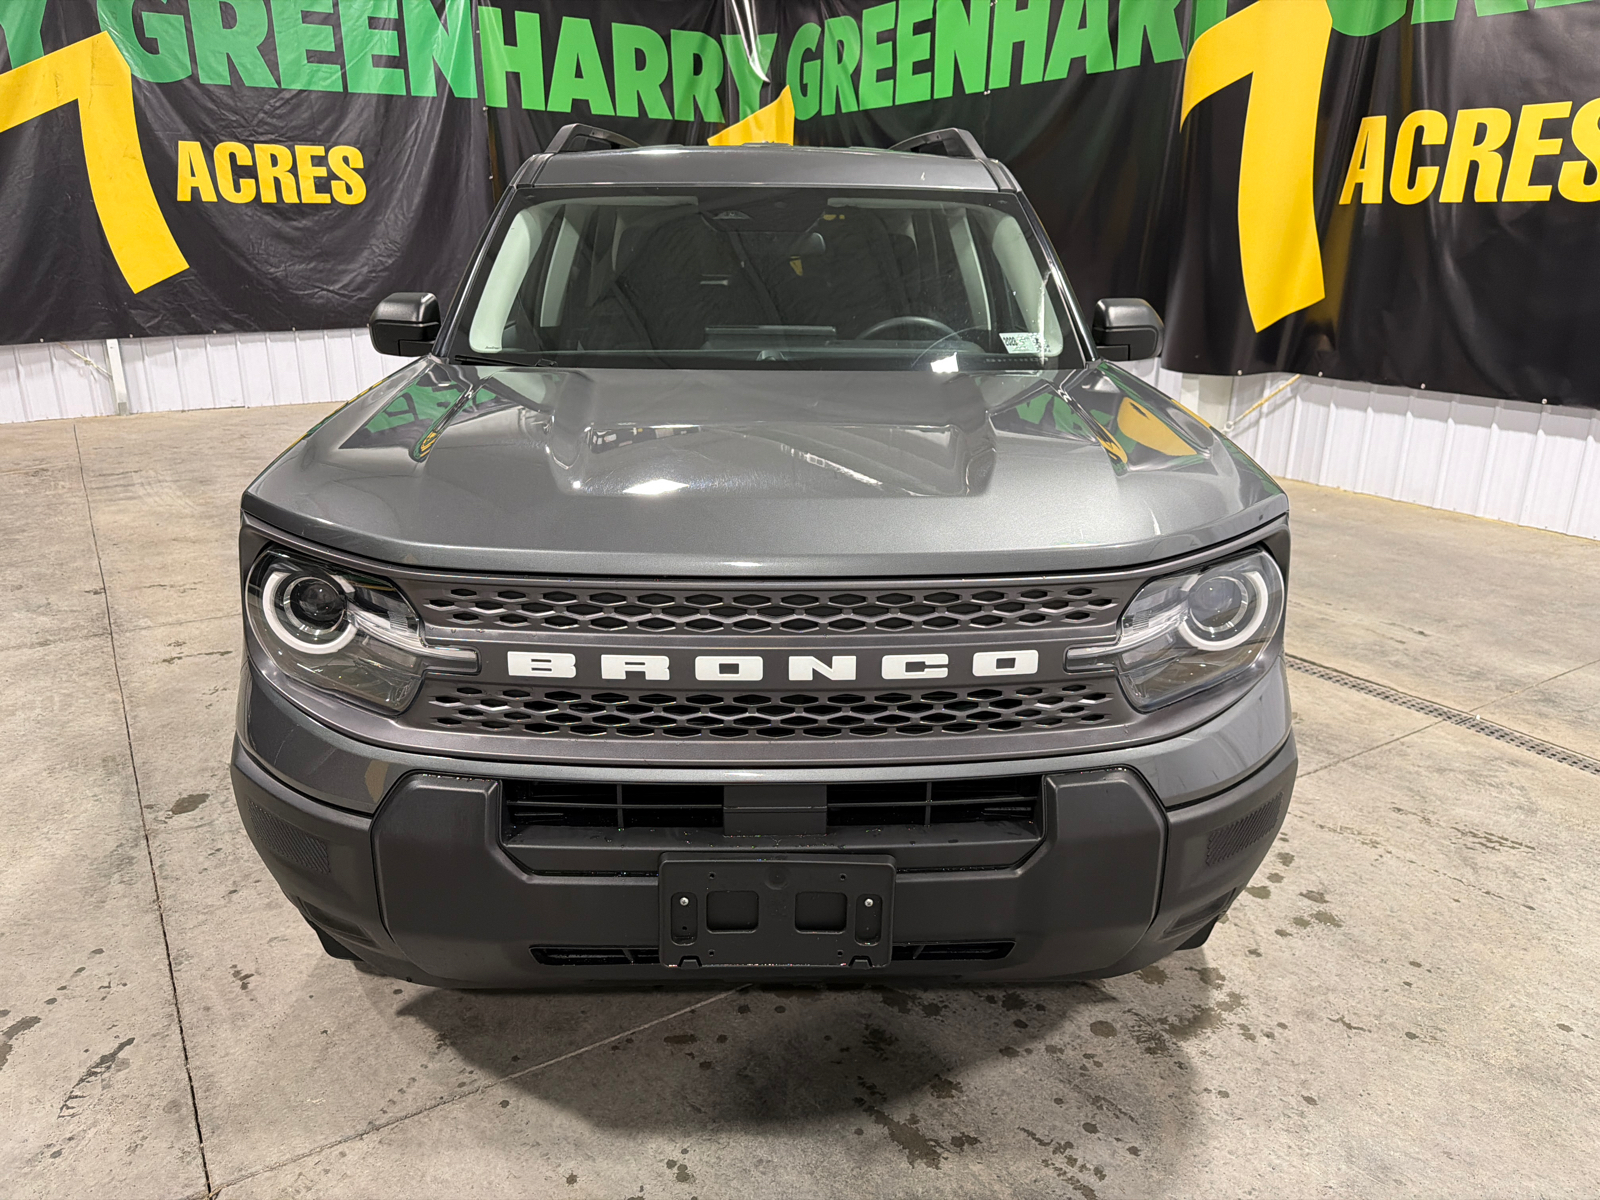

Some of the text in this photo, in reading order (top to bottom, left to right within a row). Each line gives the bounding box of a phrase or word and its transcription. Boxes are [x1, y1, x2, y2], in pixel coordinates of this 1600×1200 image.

[97, 0, 478, 98] GREEN
[478, 6, 778, 123] HARRY
[786, 0, 991, 121] GREEN
[176, 140, 367, 205] ACRES
[1180, 0, 1600, 333] 7 ACRES
[507, 650, 1038, 681] BRONCO
